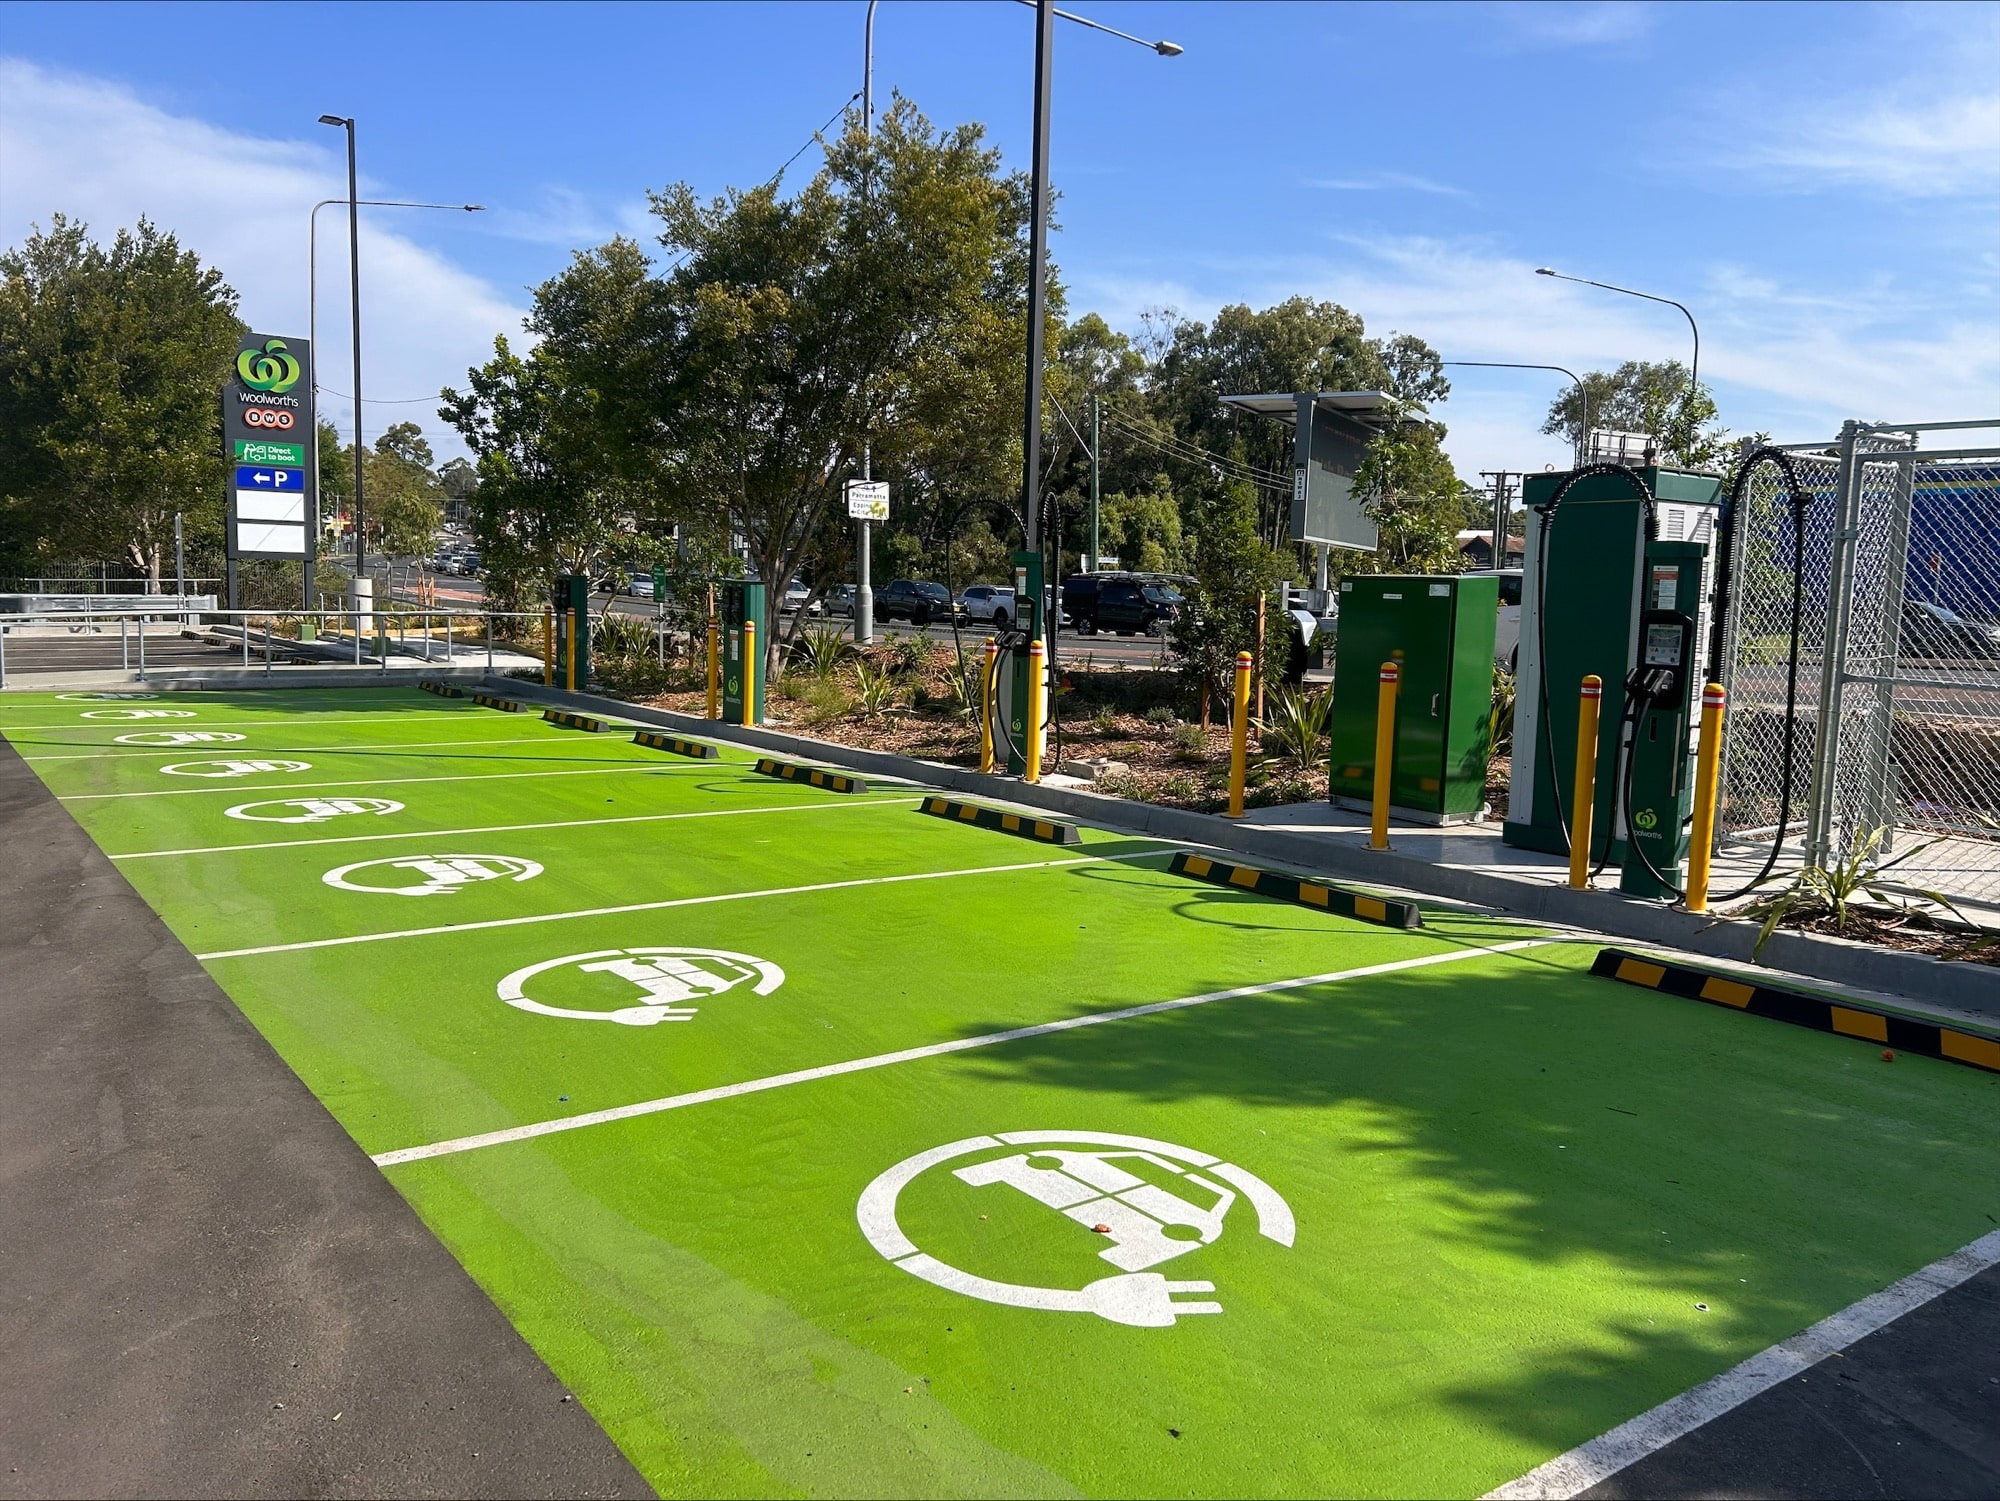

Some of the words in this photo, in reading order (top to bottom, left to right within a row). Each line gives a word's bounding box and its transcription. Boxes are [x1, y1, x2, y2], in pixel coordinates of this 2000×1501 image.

[239, 392, 299, 407] Woolworths
[268, 446, 291, 455] Direct
[277, 453, 296, 462] boot
[275, 471, 288, 488] P
[1633, 829, 1662, 840] oolworths
